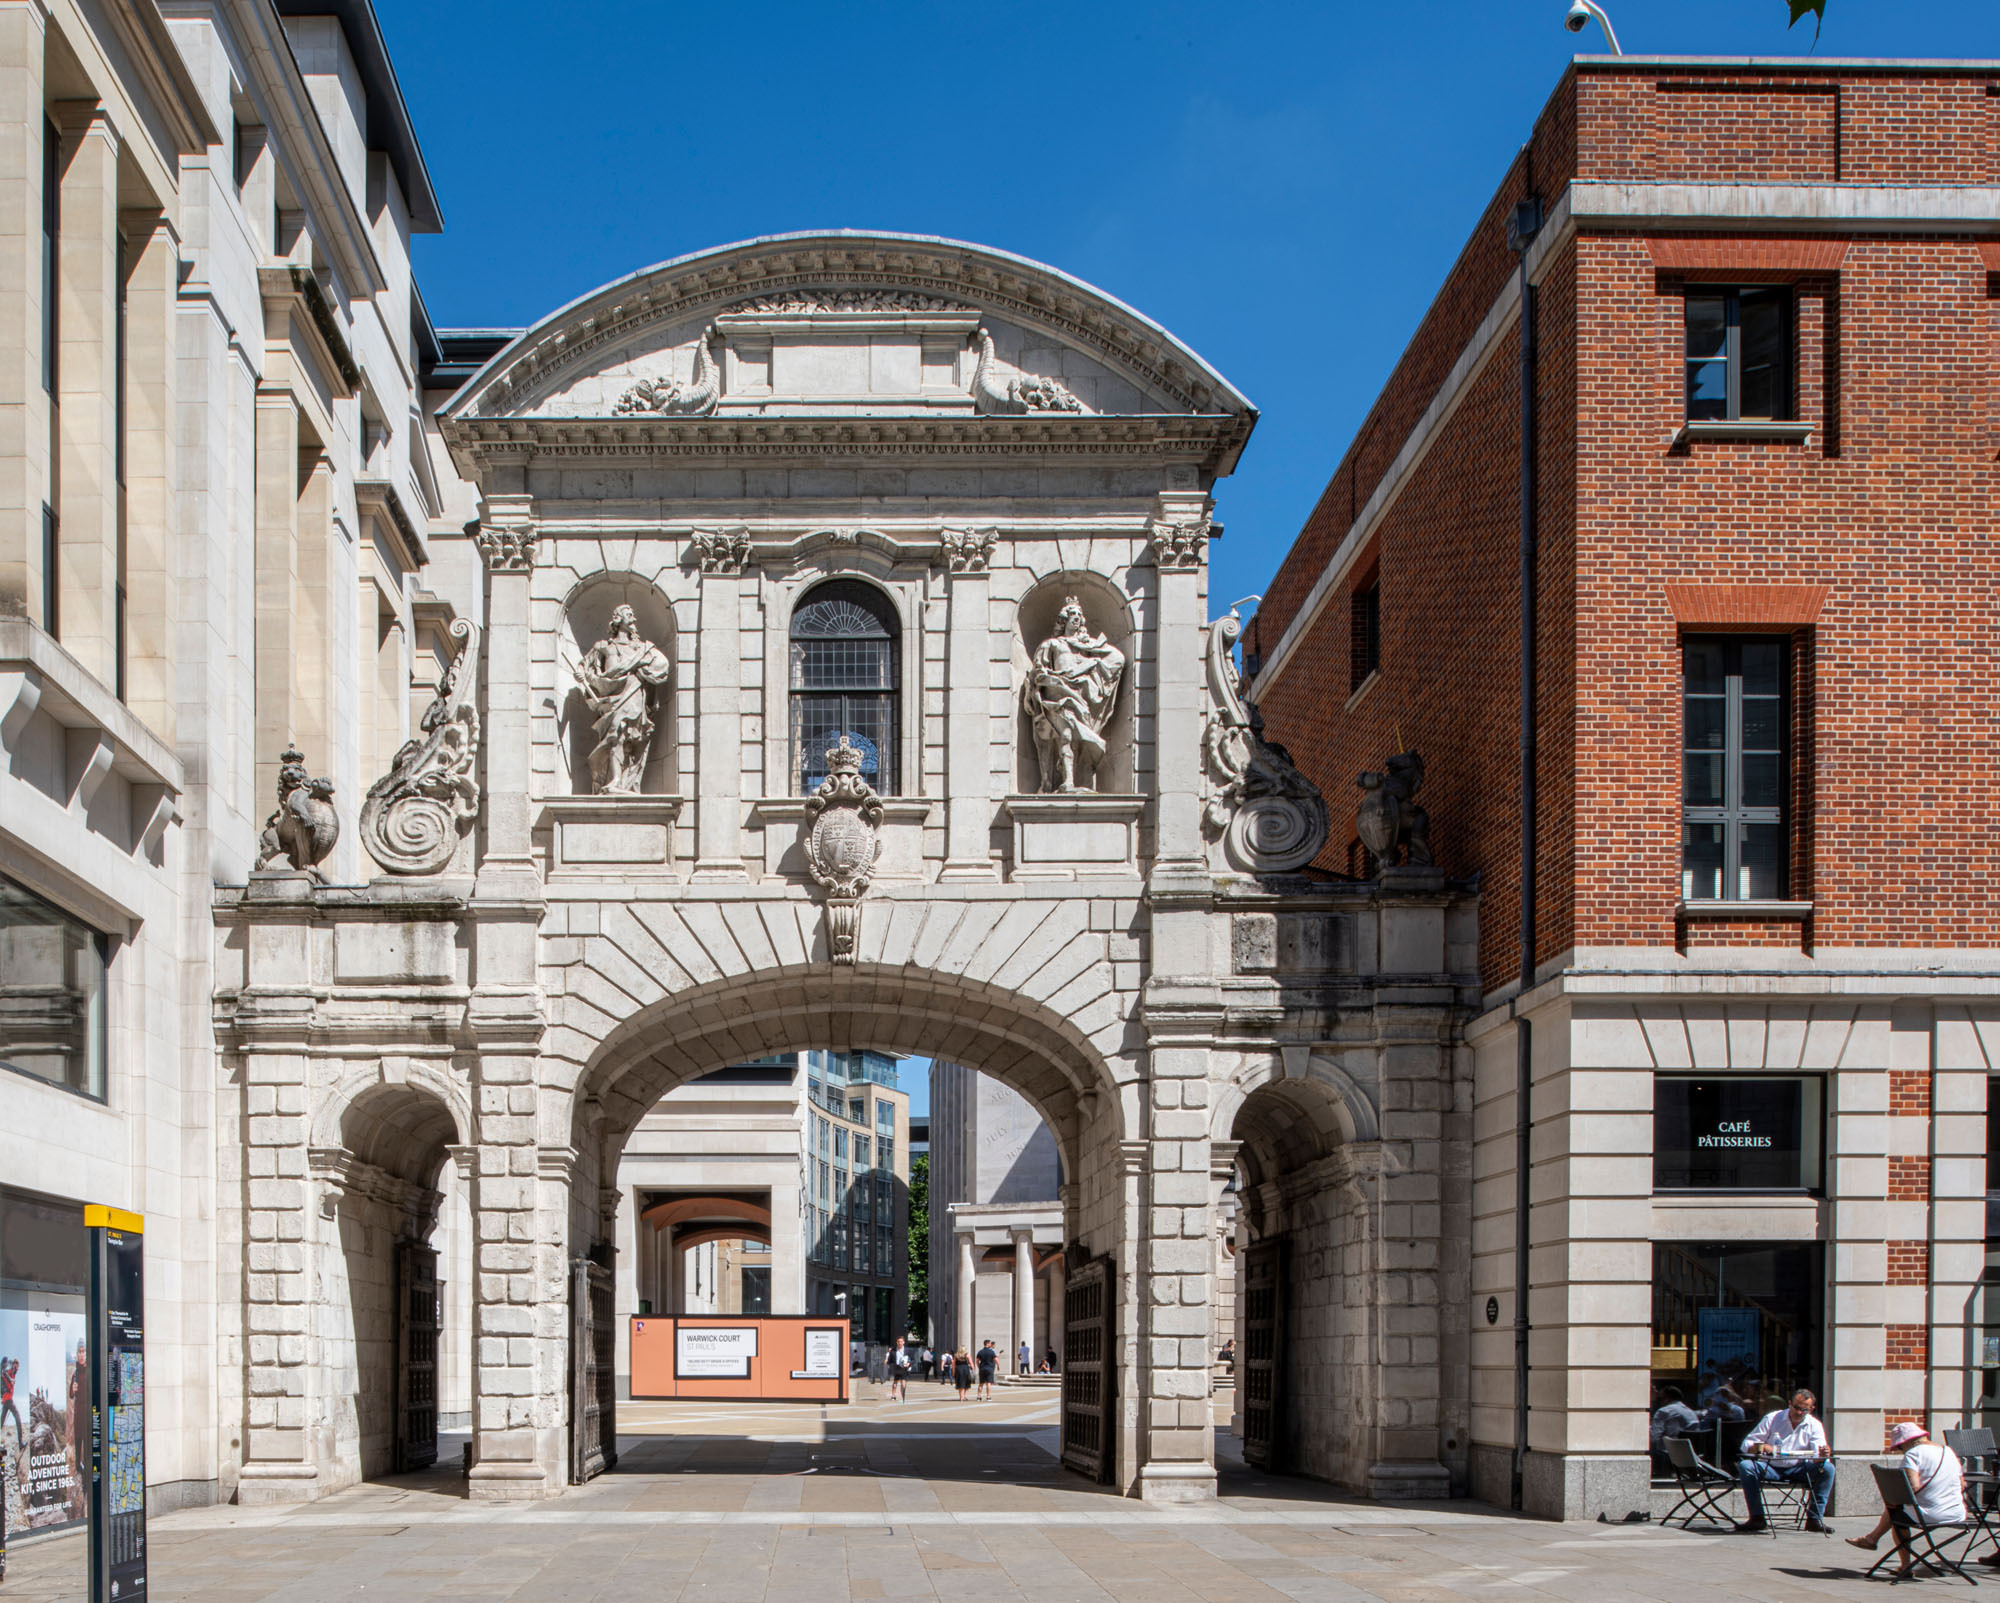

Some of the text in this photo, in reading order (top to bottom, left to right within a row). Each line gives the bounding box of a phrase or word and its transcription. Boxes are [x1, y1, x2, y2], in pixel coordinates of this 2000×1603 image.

[1718, 1120, 1751, 1133] CAFÉ
[986, 1128, 1008, 1145] JULY
[1697, 1134, 1772, 1148] PÂTISSERIES
[31, 1452, 66, 1466] OUTDOOR
[27, 1465, 70, 1480] ADVENTURE
[21, 1477, 75, 1495] KIT, SINCE 1965.
[53, 1502, 62, 1511] FOR
